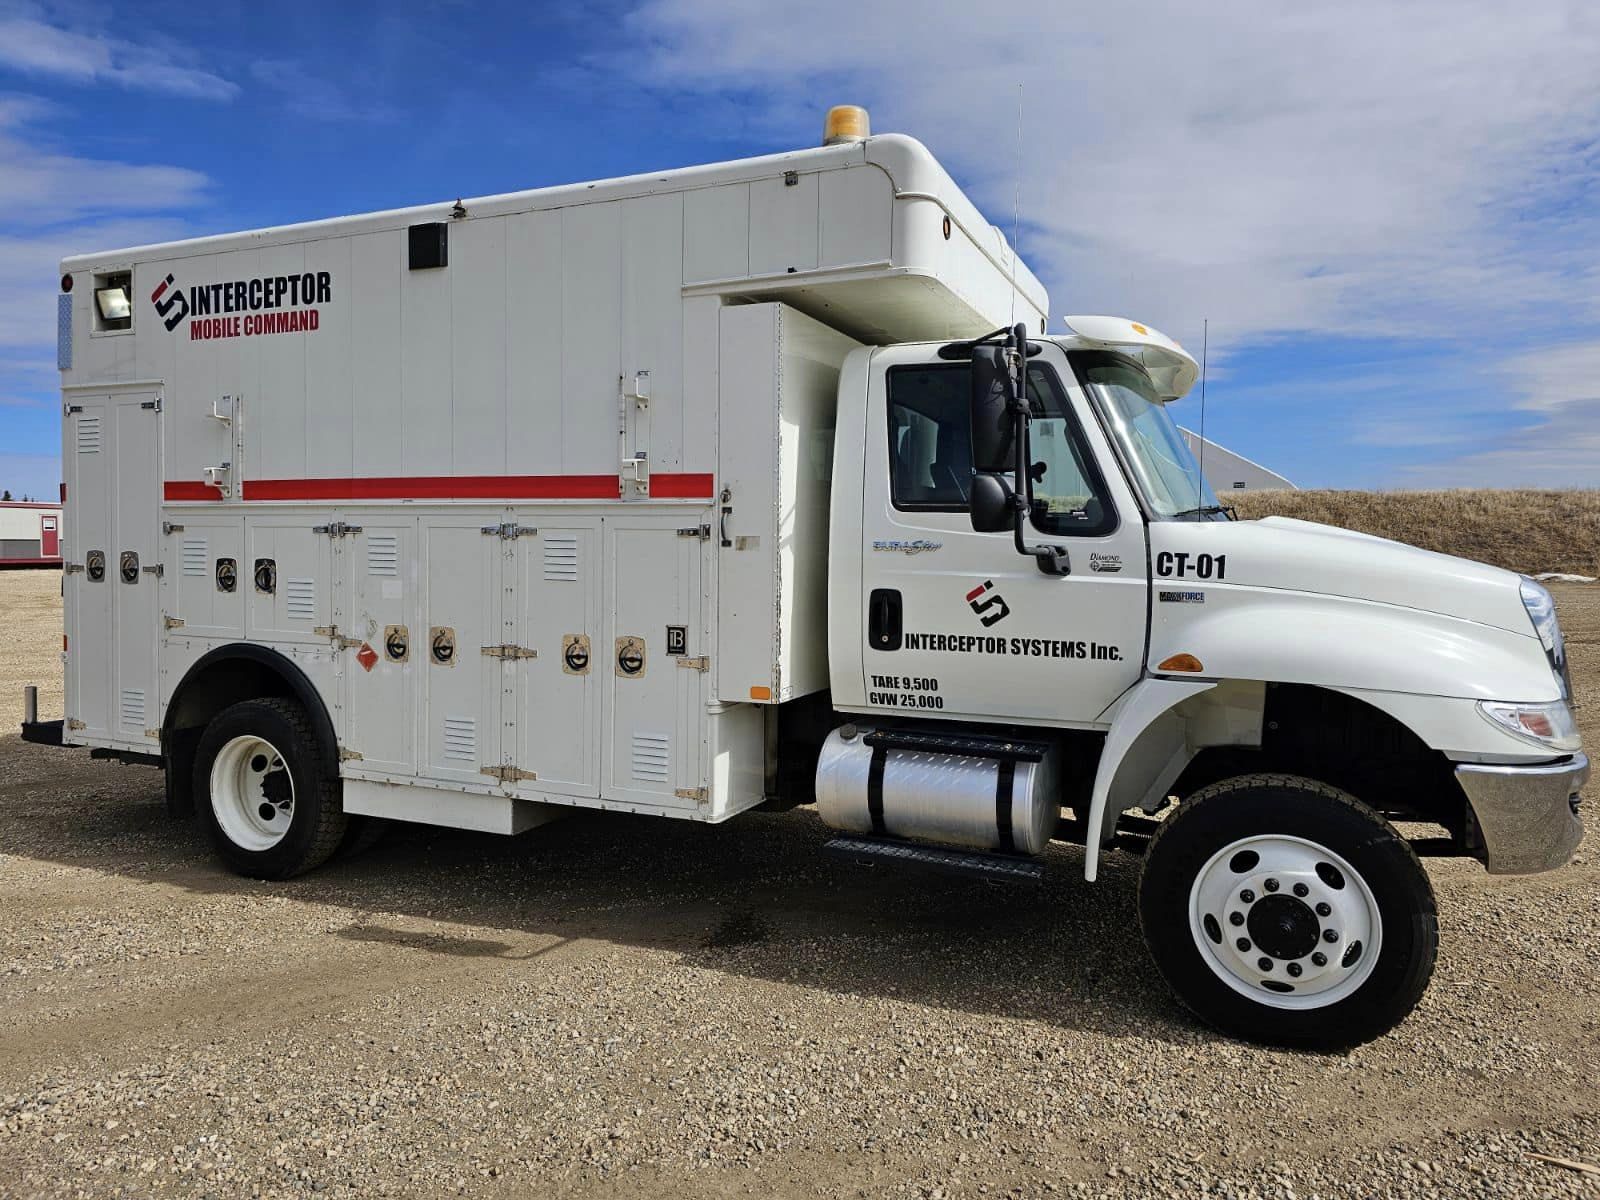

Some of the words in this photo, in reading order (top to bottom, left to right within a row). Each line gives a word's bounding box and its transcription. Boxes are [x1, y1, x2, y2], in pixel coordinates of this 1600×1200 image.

[190, 271, 332, 316] INTERCEPTOR
[190, 317, 241, 341] MOBILE
[243, 309, 320, 337] COMMAND
[1156, 551, 1226, 579] CT-01
[904, 632, 1007, 655] INTERCEPTOR
[1010, 638, 1087, 659] SYSTEMS
[1090, 641, 1124, 662] Inc.
[871, 675, 900, 689] TARE
[902, 676, 939, 692] 9,500
[869, 692, 898, 706] GVW
[900, 695, 944, 709] 25,000
